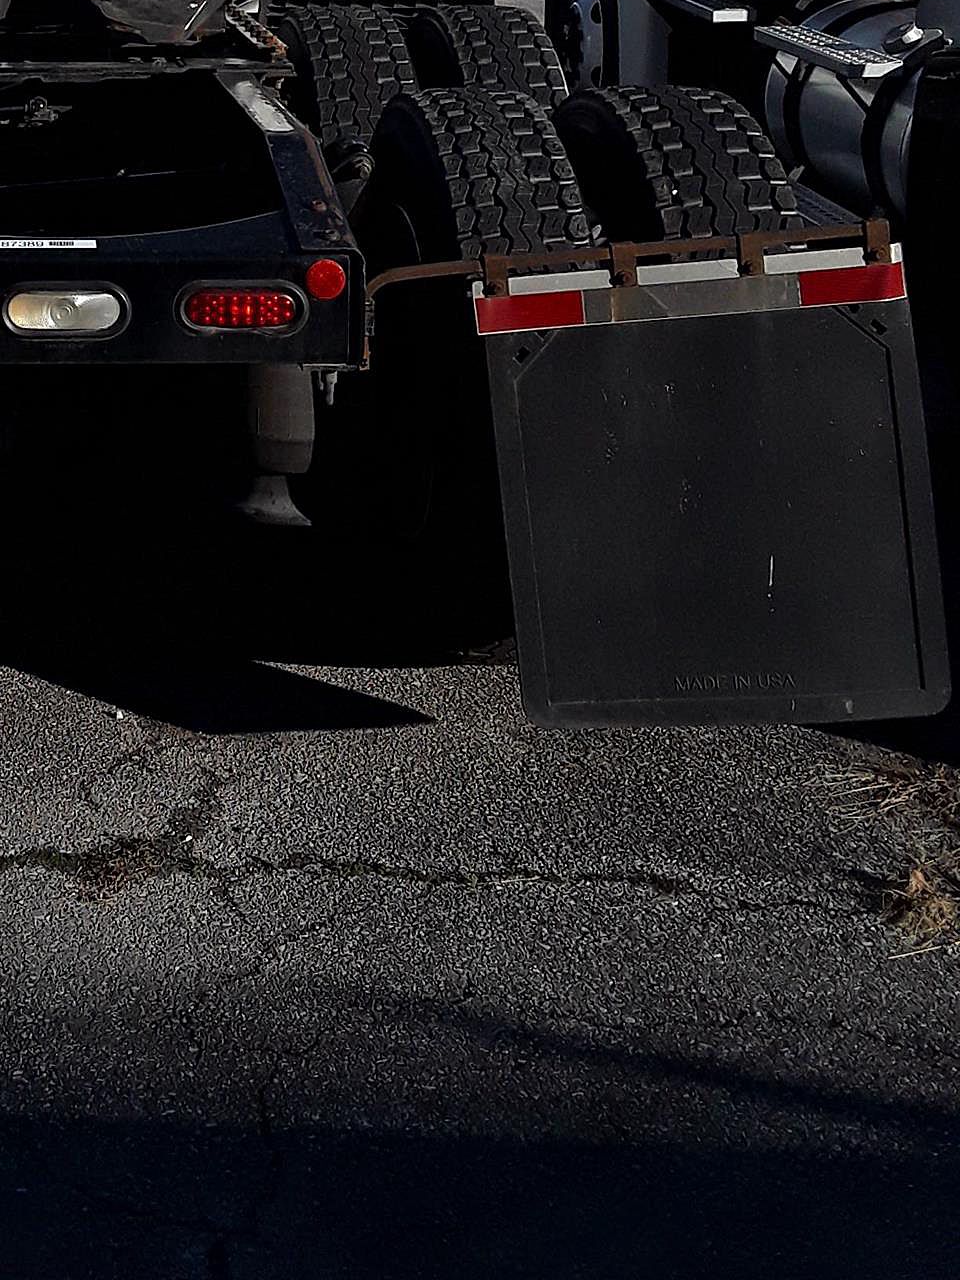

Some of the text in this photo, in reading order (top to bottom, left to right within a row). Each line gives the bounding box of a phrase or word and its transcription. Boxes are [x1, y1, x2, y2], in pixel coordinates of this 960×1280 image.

[673, 672, 797, 691] MADE IN USA
